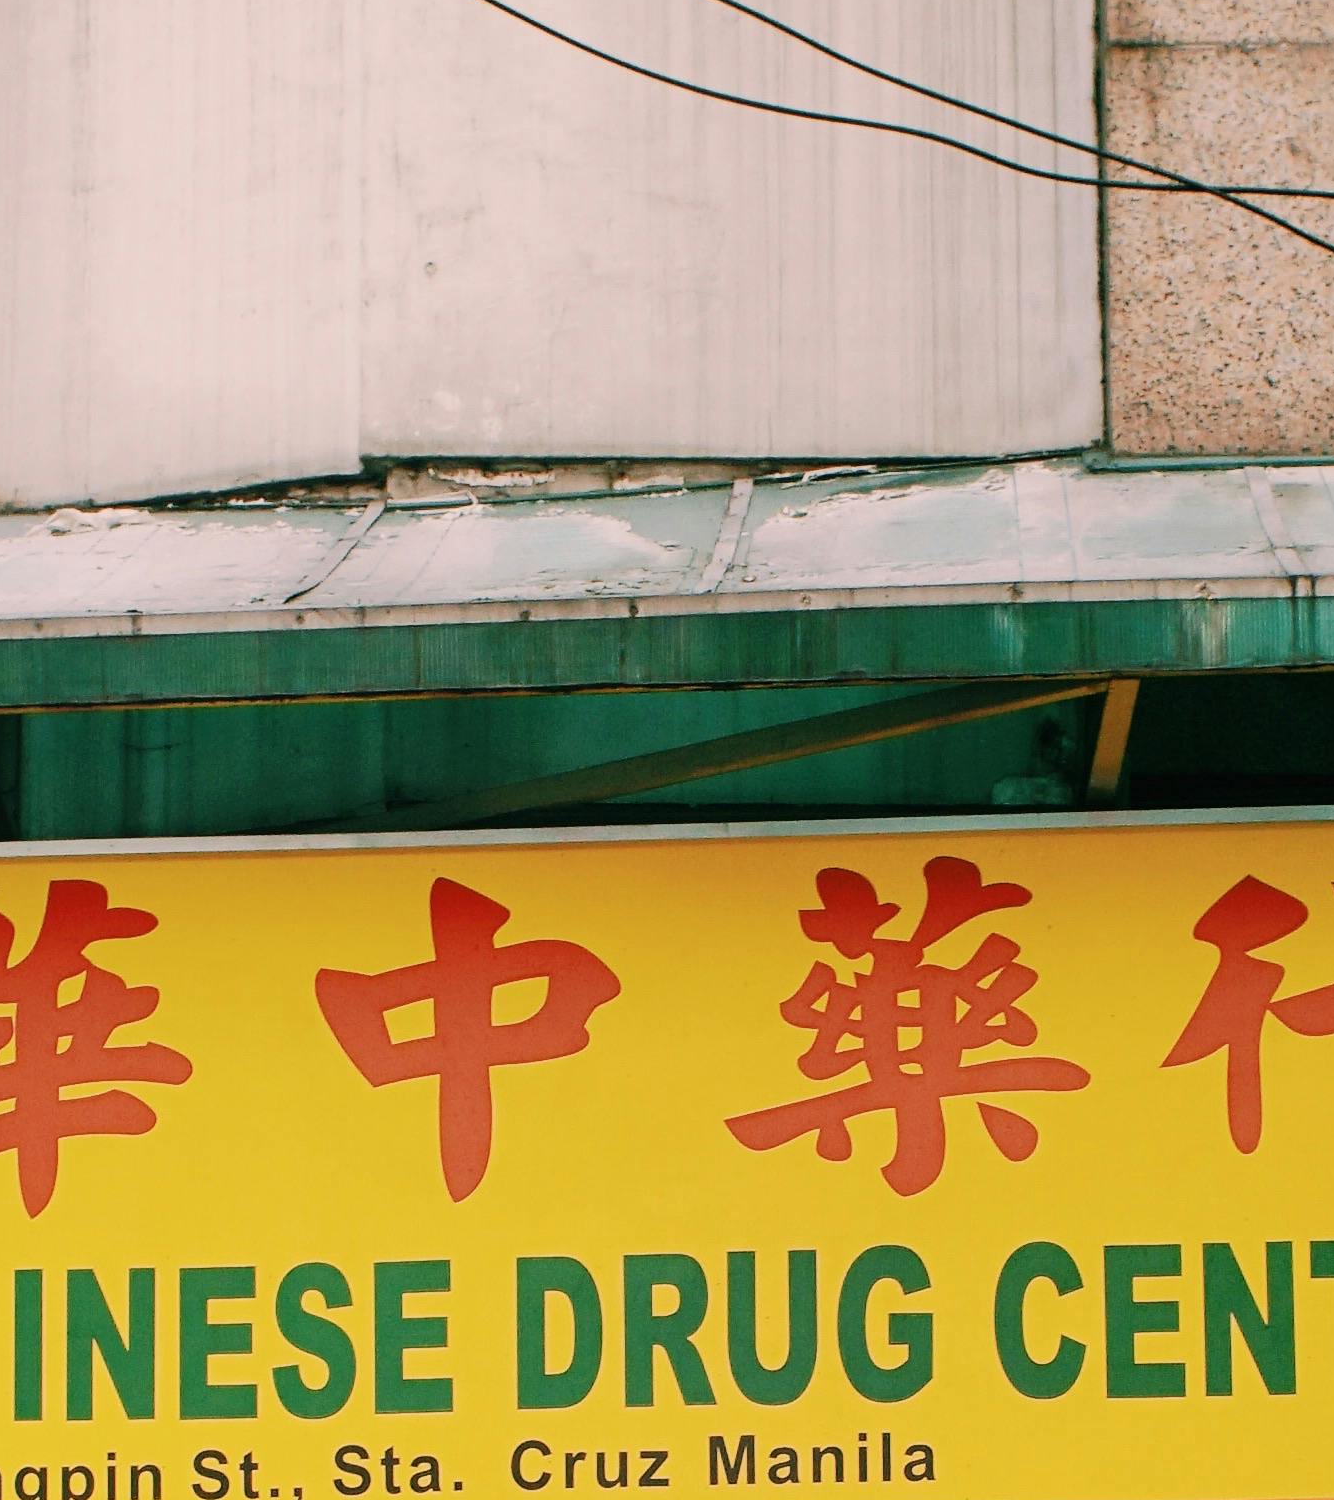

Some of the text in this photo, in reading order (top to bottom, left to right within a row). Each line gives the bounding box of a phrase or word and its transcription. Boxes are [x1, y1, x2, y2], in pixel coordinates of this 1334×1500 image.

[516, 1244, 934, 1410] DRUG
[333, 1443, 464, 1497] Sta.
[509, 1438, 670, 1491] Cruz
[708, 1431, 936, 1487] Manila
